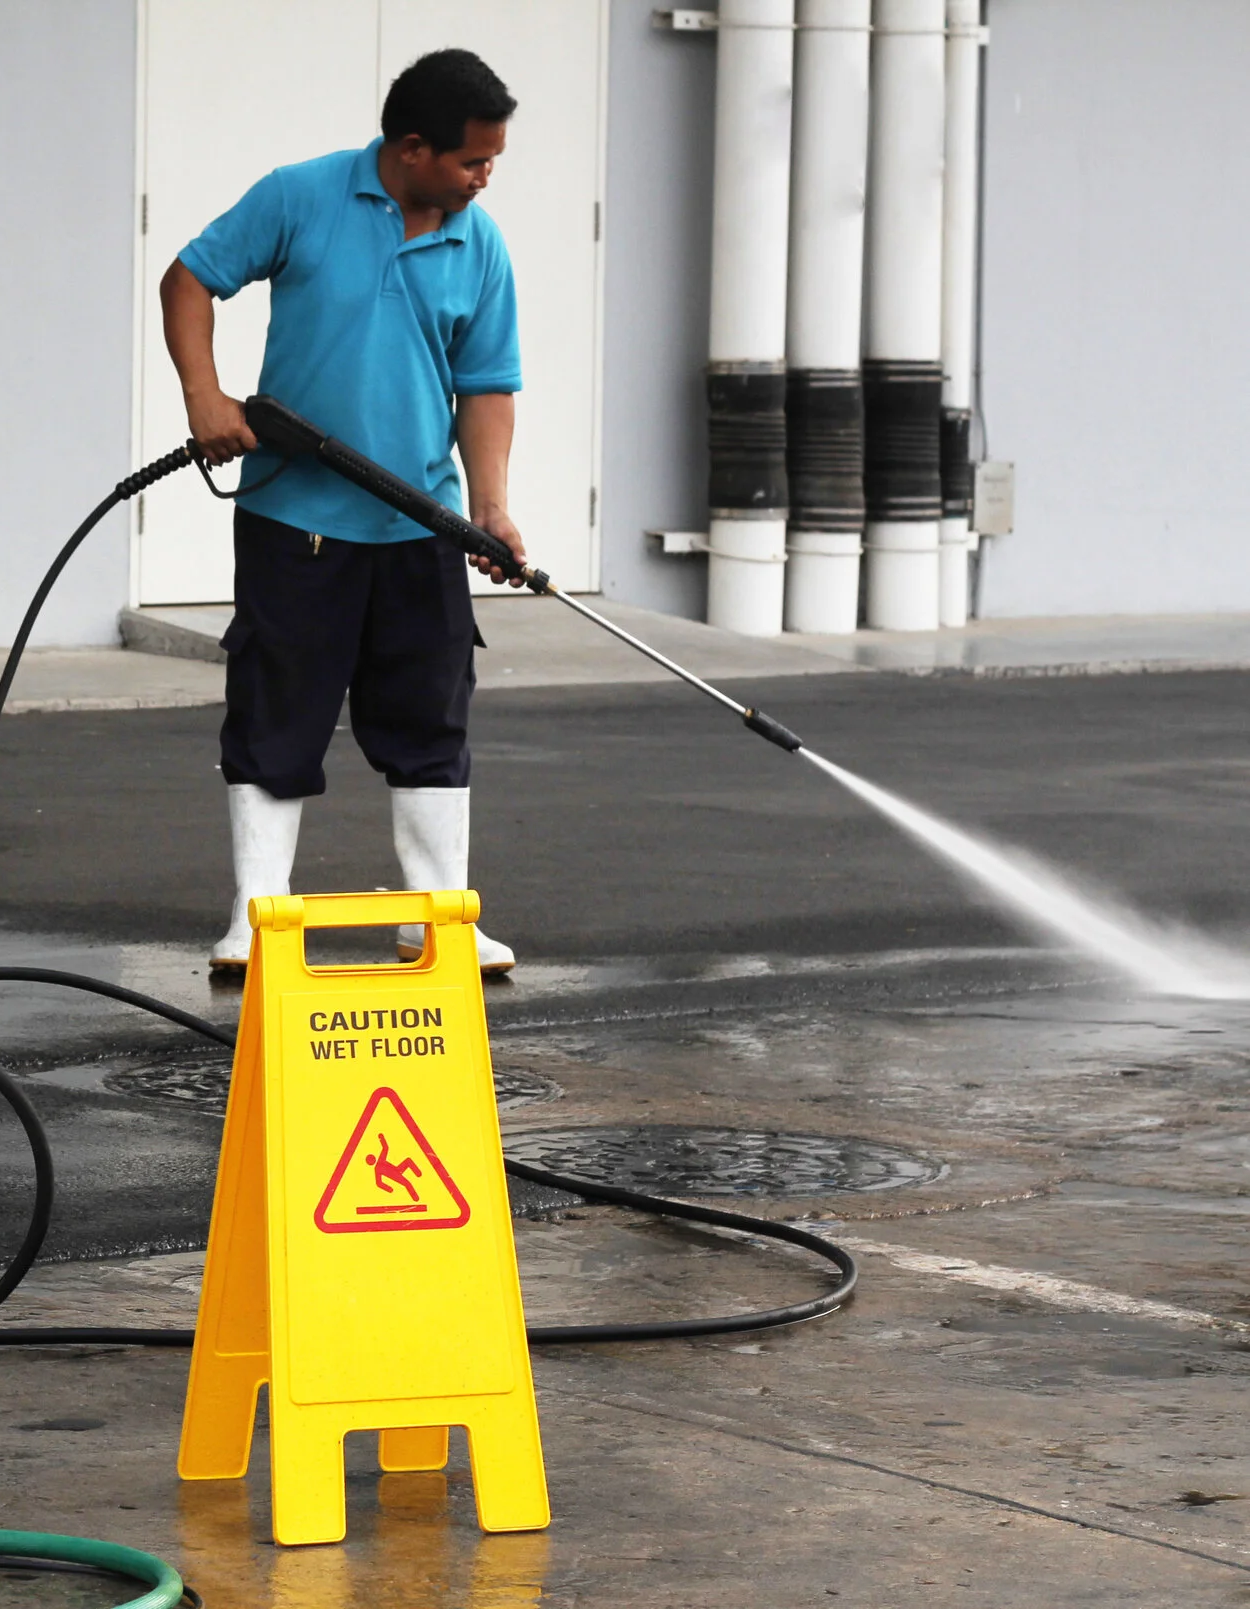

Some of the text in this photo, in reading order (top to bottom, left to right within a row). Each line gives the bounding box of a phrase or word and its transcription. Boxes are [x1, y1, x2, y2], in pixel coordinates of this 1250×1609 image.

[310, 1008, 442, 1032] CAUTION
[310, 1036, 445, 1060] WET FLOOR
